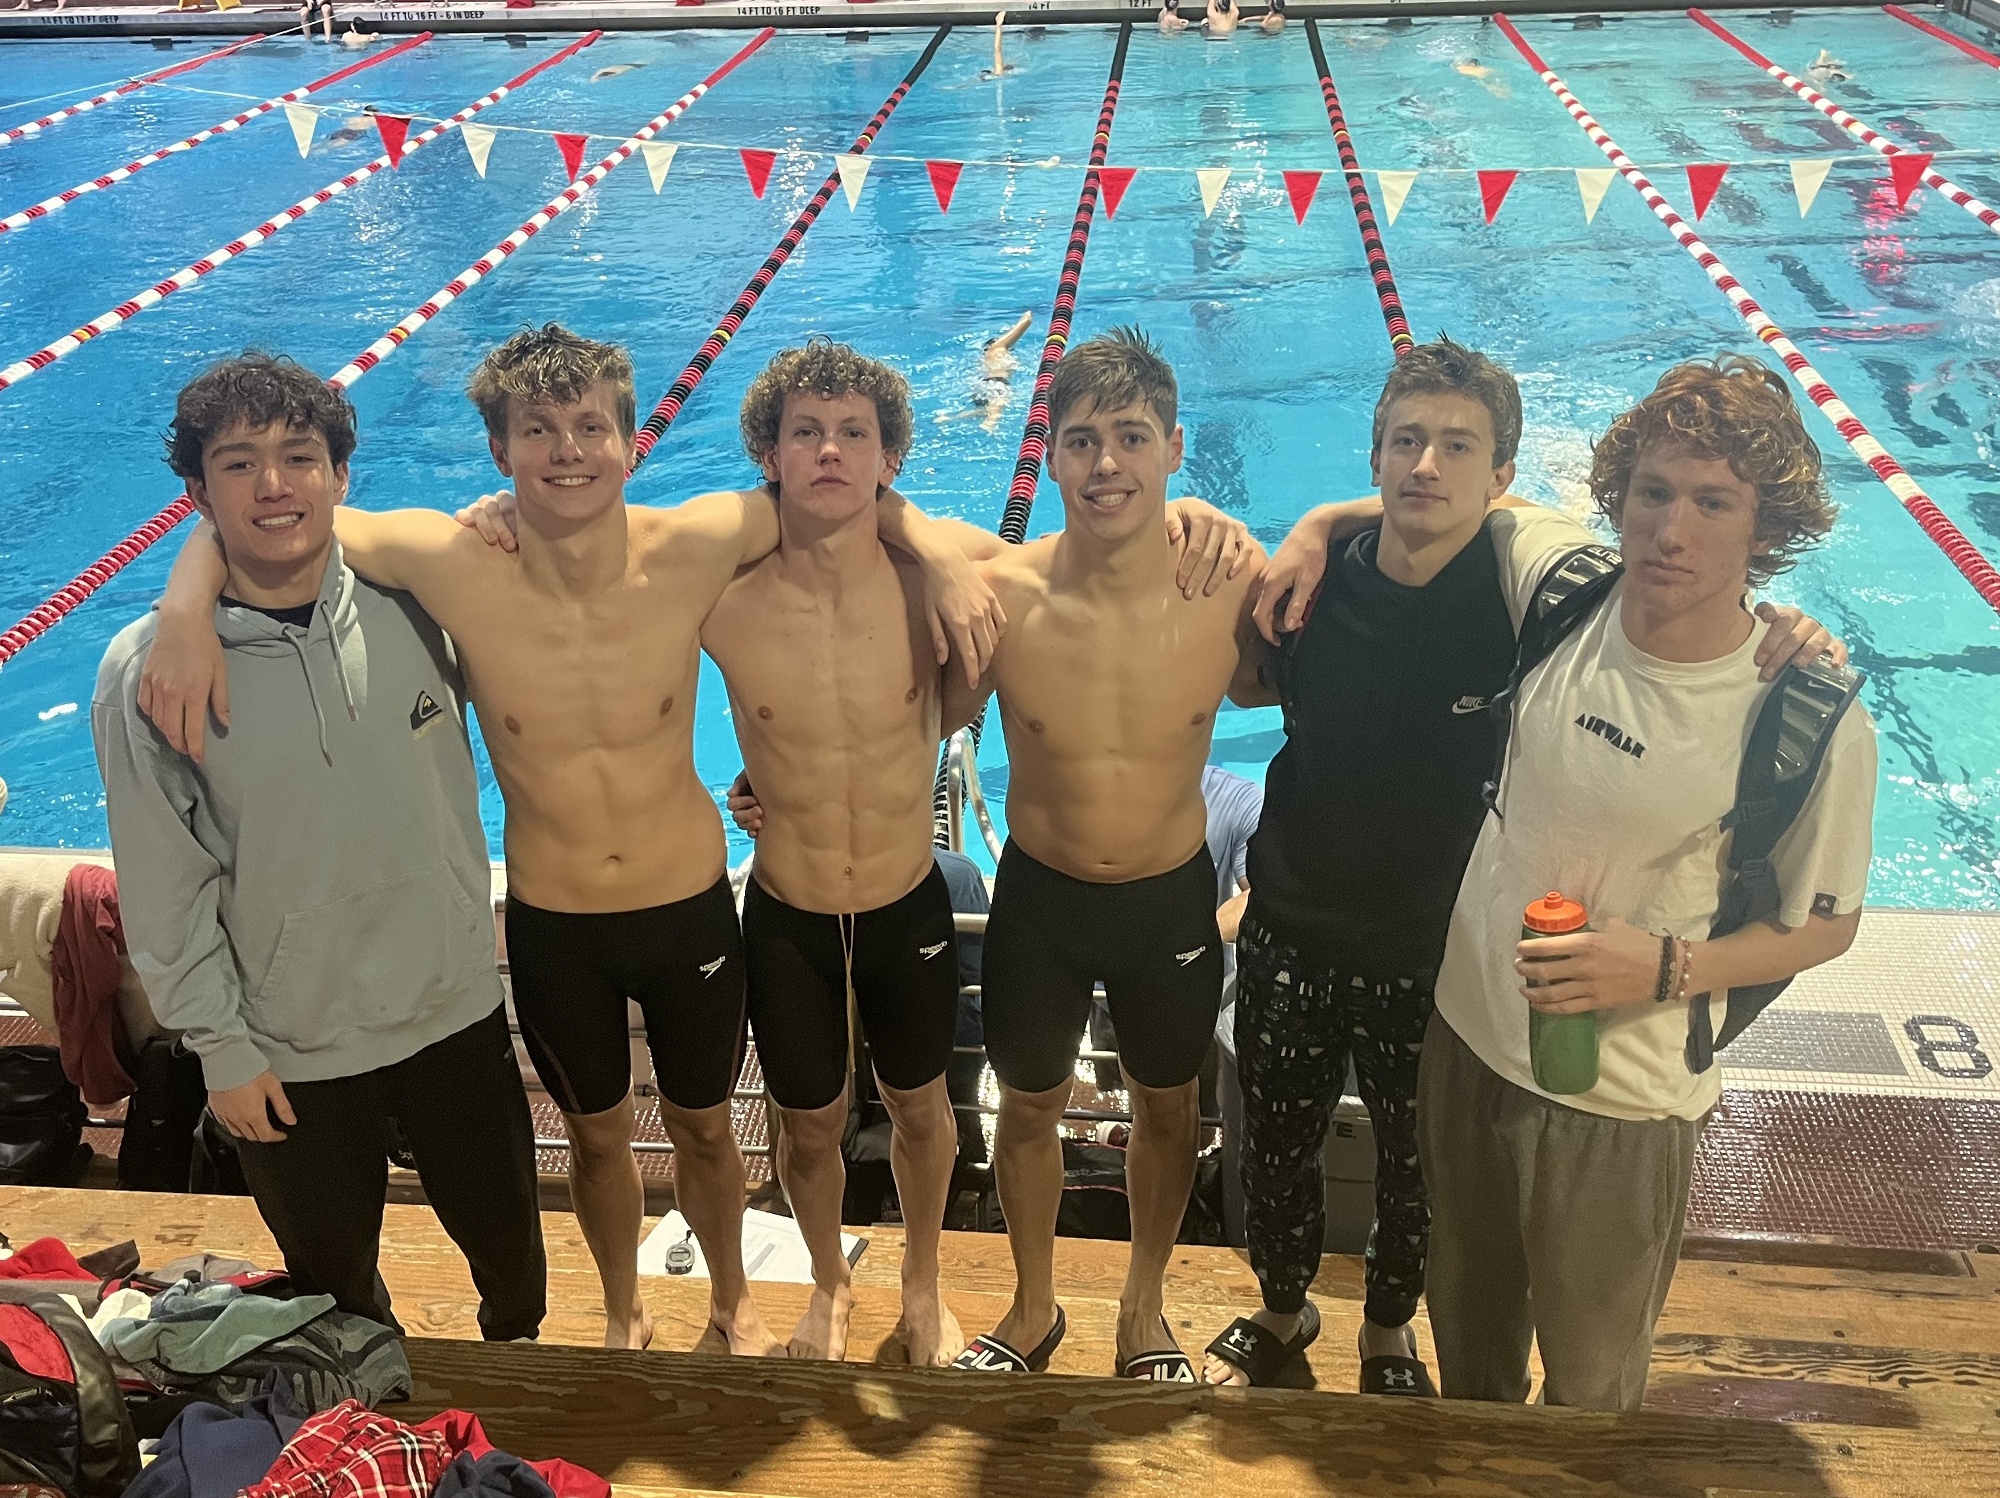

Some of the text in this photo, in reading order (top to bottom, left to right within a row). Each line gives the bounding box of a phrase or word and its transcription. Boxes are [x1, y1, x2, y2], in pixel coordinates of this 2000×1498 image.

[380, 12, 389, 20] 14
[392, 12, 400, 20] FT
[403, 12, 414, 20] TO
[416, 12, 426, 20] 16
[427, 11, 437, 19] FT
[446, 11, 451, 19] 6
[453, 11, 462, 19] IN
[464, 11, 485, 19] DEEP
[737, 7, 747, 15] 14
[749, 7, 759, 15] FT
[761, 7, 772, 15] TO
[774, 7, 783, 15] 16
[786, 7, 796, 15] FT
[53, 16, 63, 24] FT
[87, 15, 96, 23] FT
[1458, 695, 1485, 708] NIKE
[1574, 713, 1647, 759] AIRWALK
[1903, 1015, 1994, 1079] 8
